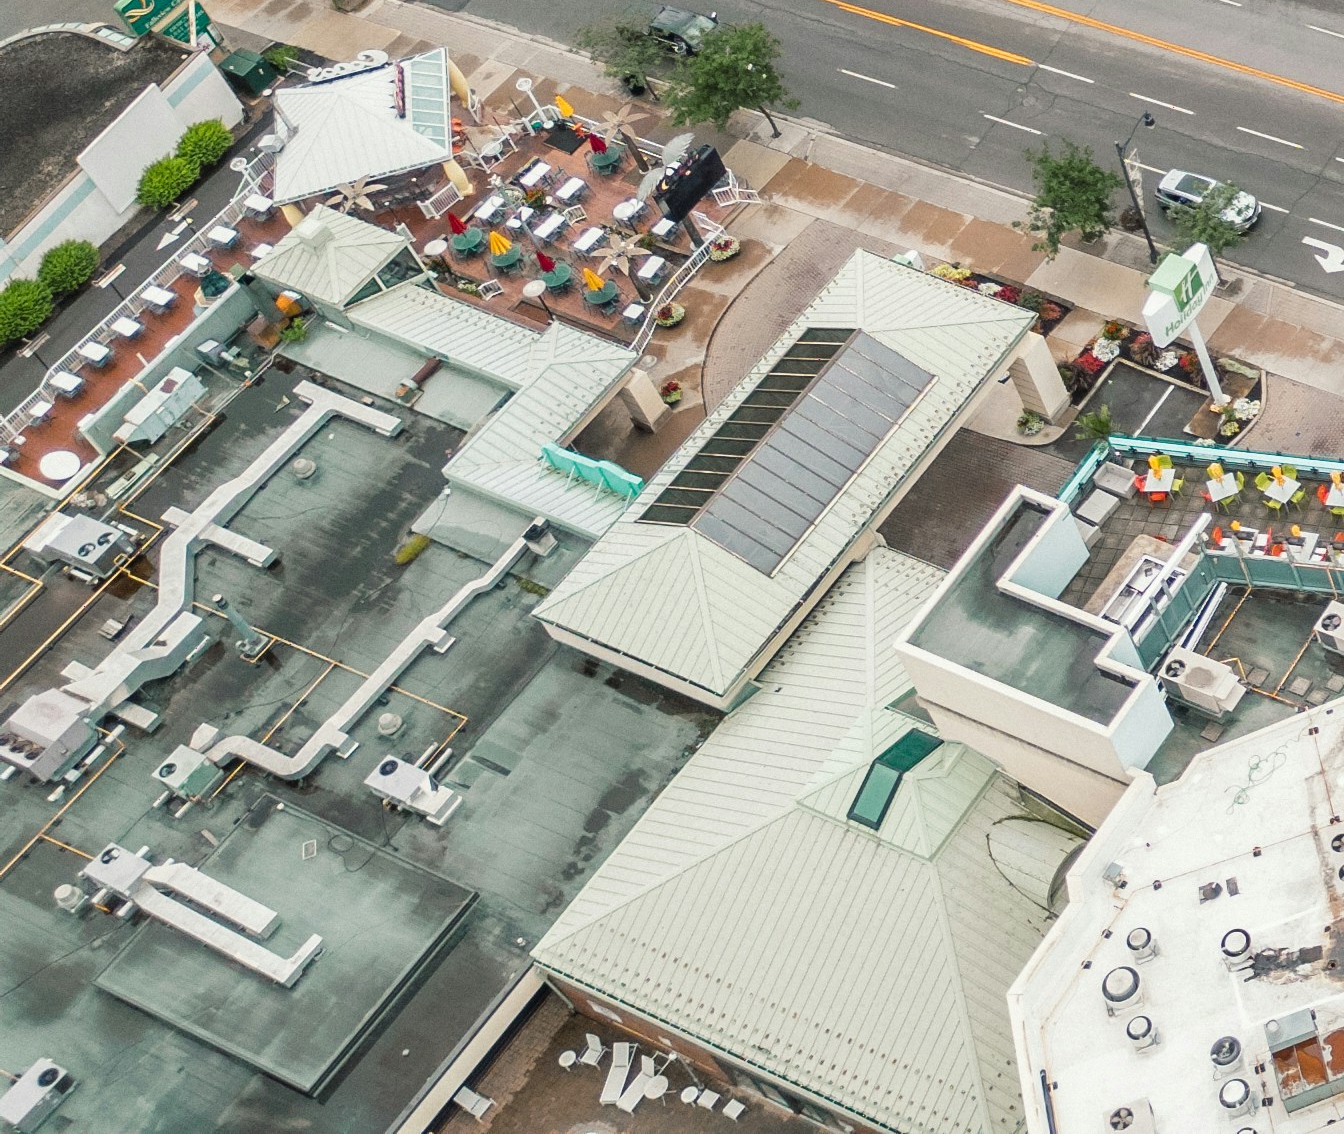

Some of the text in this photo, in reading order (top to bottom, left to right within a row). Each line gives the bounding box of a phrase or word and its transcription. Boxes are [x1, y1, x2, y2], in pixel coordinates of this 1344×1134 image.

[144, 6, 172, 29] Fallsview
[1165, 273, 1214, 336] Holiday Inn
